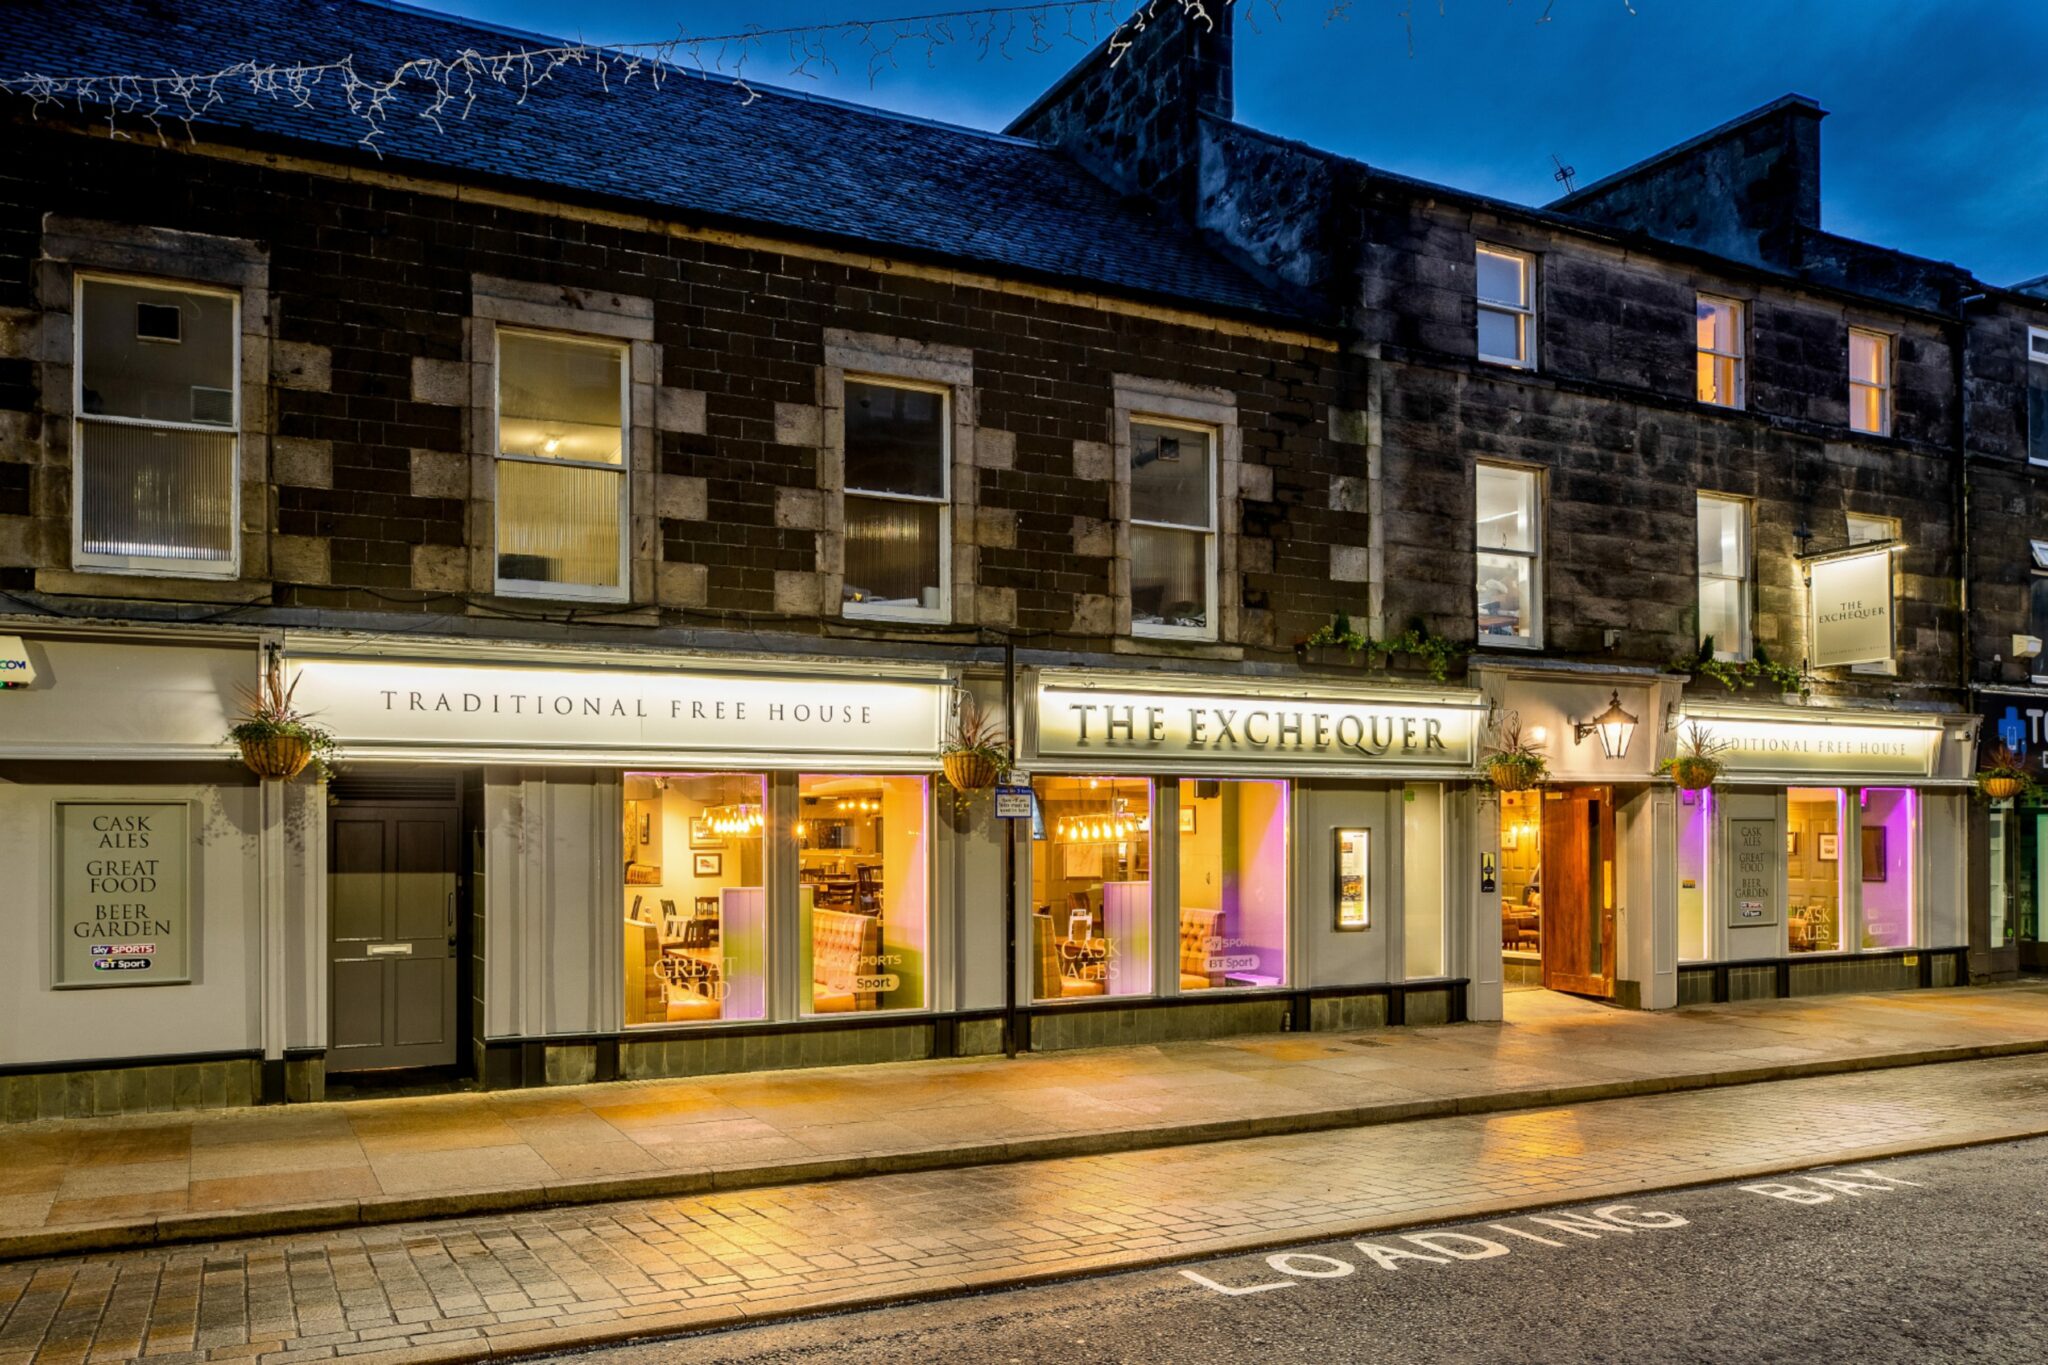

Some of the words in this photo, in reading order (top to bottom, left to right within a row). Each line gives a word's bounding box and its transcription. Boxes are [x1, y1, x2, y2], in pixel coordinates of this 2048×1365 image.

[1839, 600, 1863, 611] THE
[1818, 606, 1885, 624] EXCHEQUER
[380, 690, 648, 717] TRADITIONAL
[670, 700, 747, 721] FREE
[768, 703, 872, 724] HOUSE
[1069, 703, 1166, 743] THE
[1187, 707, 1449, 756] EXCHEQUER
[1818, 740, 1851, 754] FREE
[1860, 742, 1906, 756] HOUSE
[92, 815, 152, 832] CASK
[1741, 826, 1763, 837] CASK
[98, 832, 150, 849] ALES
[1743, 837, 1762, 847] ALES
[1740, 852, 1765, 863] GREAT
[86, 860, 160, 877] GREAT
[1741, 862, 1764, 873] FOOD
[90, 877, 157, 894] FOOD
[1742, 878, 1761, 888] BEER
[1735, 888, 1769, 899] GARDEN
[95, 903, 150, 921] BEER
[73, 919, 171, 938] GARDEN
[1798, 924, 1830, 942] ALES
[93, 945, 109, 956] sky
[112, 944, 154, 954] SPORTS
[1061, 937, 1122, 960] CASK
[100, 959, 116, 969] BT
[118, 959, 146, 970] Sport
[653, 957, 738, 979] GREAT
[1066, 960, 1120, 981] ALES
[1208, 958, 1224, 969] BT
[1226, 956, 1254, 970] Sport
[855, 976, 892, 991] Sport
[1178, 1204, 1691, 1297] LOADING
[1738, 1168, 1922, 1205] BAY
